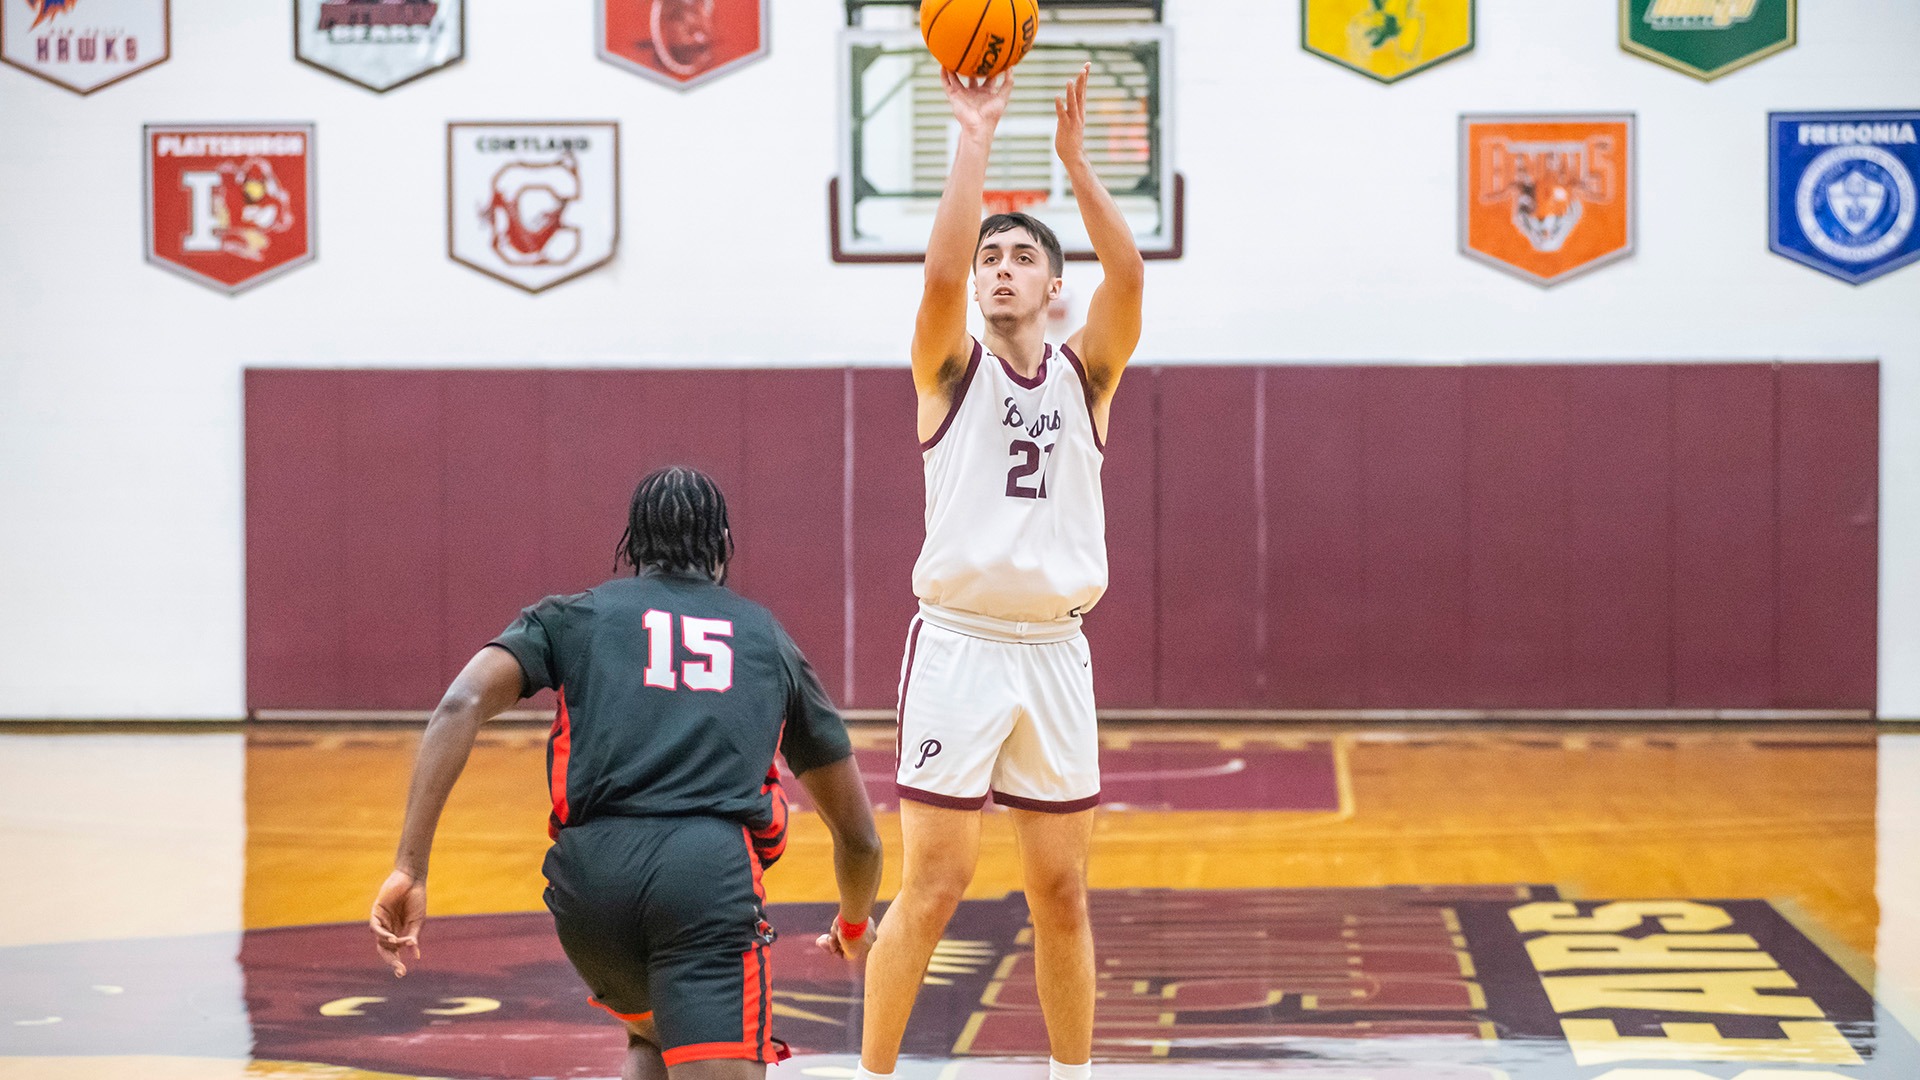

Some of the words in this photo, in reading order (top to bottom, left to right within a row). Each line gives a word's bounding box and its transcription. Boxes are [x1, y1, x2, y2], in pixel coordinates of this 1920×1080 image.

[37, 37, 137, 62] HAWKS
[475, 136, 589, 151] CORTLAND
[1798, 123, 1918, 146] FREDONIA
[1003, 397, 1061, 439] Bars
[641, 607, 735, 693] 15
[914, 738, 943, 769] P
[1508, 901, 1866, 1080] EARS
